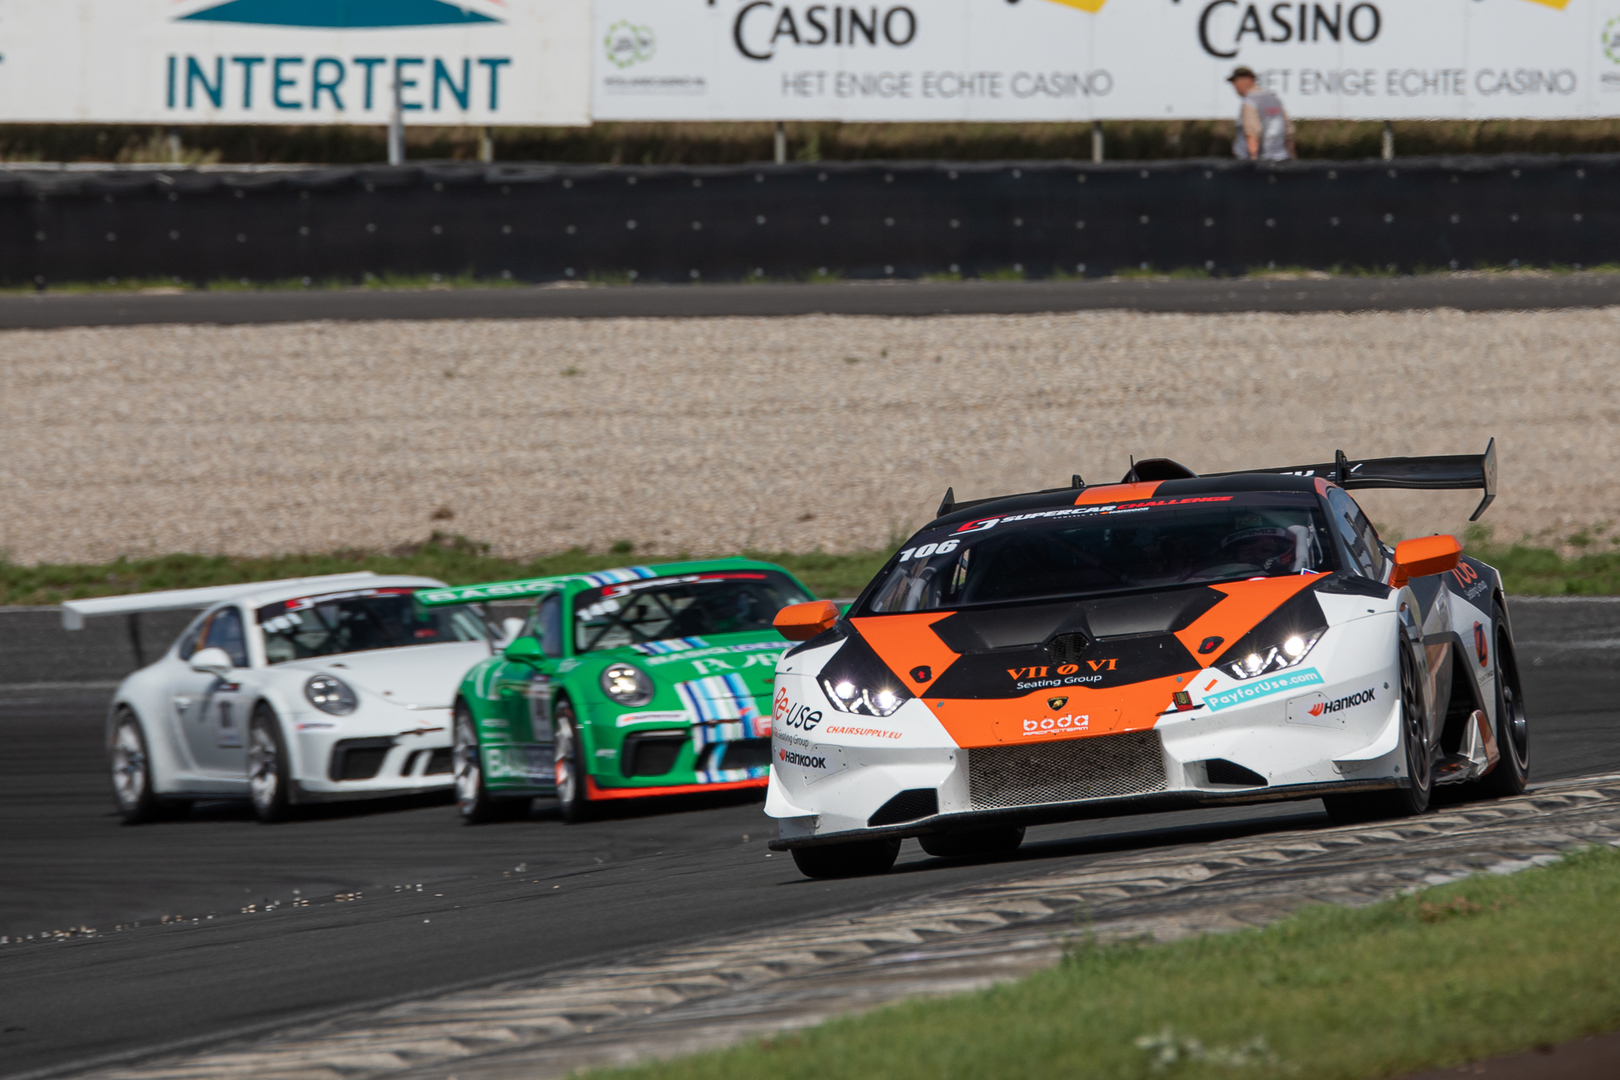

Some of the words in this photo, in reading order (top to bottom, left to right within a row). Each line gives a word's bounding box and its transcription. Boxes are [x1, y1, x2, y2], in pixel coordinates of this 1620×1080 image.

[732, 1, 918, 60] CASINO
[1198, 0, 1382, 58] CASINO
[166, 55, 512, 111] INTERTENT
[782, 71, 826, 98] HET
[836, 71, 912, 98] ENIGE
[922, 70, 1003, 98] ECHTE
[1011, 68, 1114, 98] CASINO
[1300, 69, 1376, 96] ENIGE
[1386, 69, 1467, 96] ECHTE
[1474, 68, 1578, 96] CASINO
[1000, 505, 1117, 524] SUPERCAR
[1117, 496, 1234, 510] CHALLENGE
[899, 539, 960, 563] 106
[1016, 678, 1062, 690] Seating
[1064, 674, 1103, 687] Group
[1208, 671, 1319, 708] PayforUse.com
[826, 725, 903, 739] CHAIRSUPPLY.EU
[1023, 714, 1089, 731] boda
